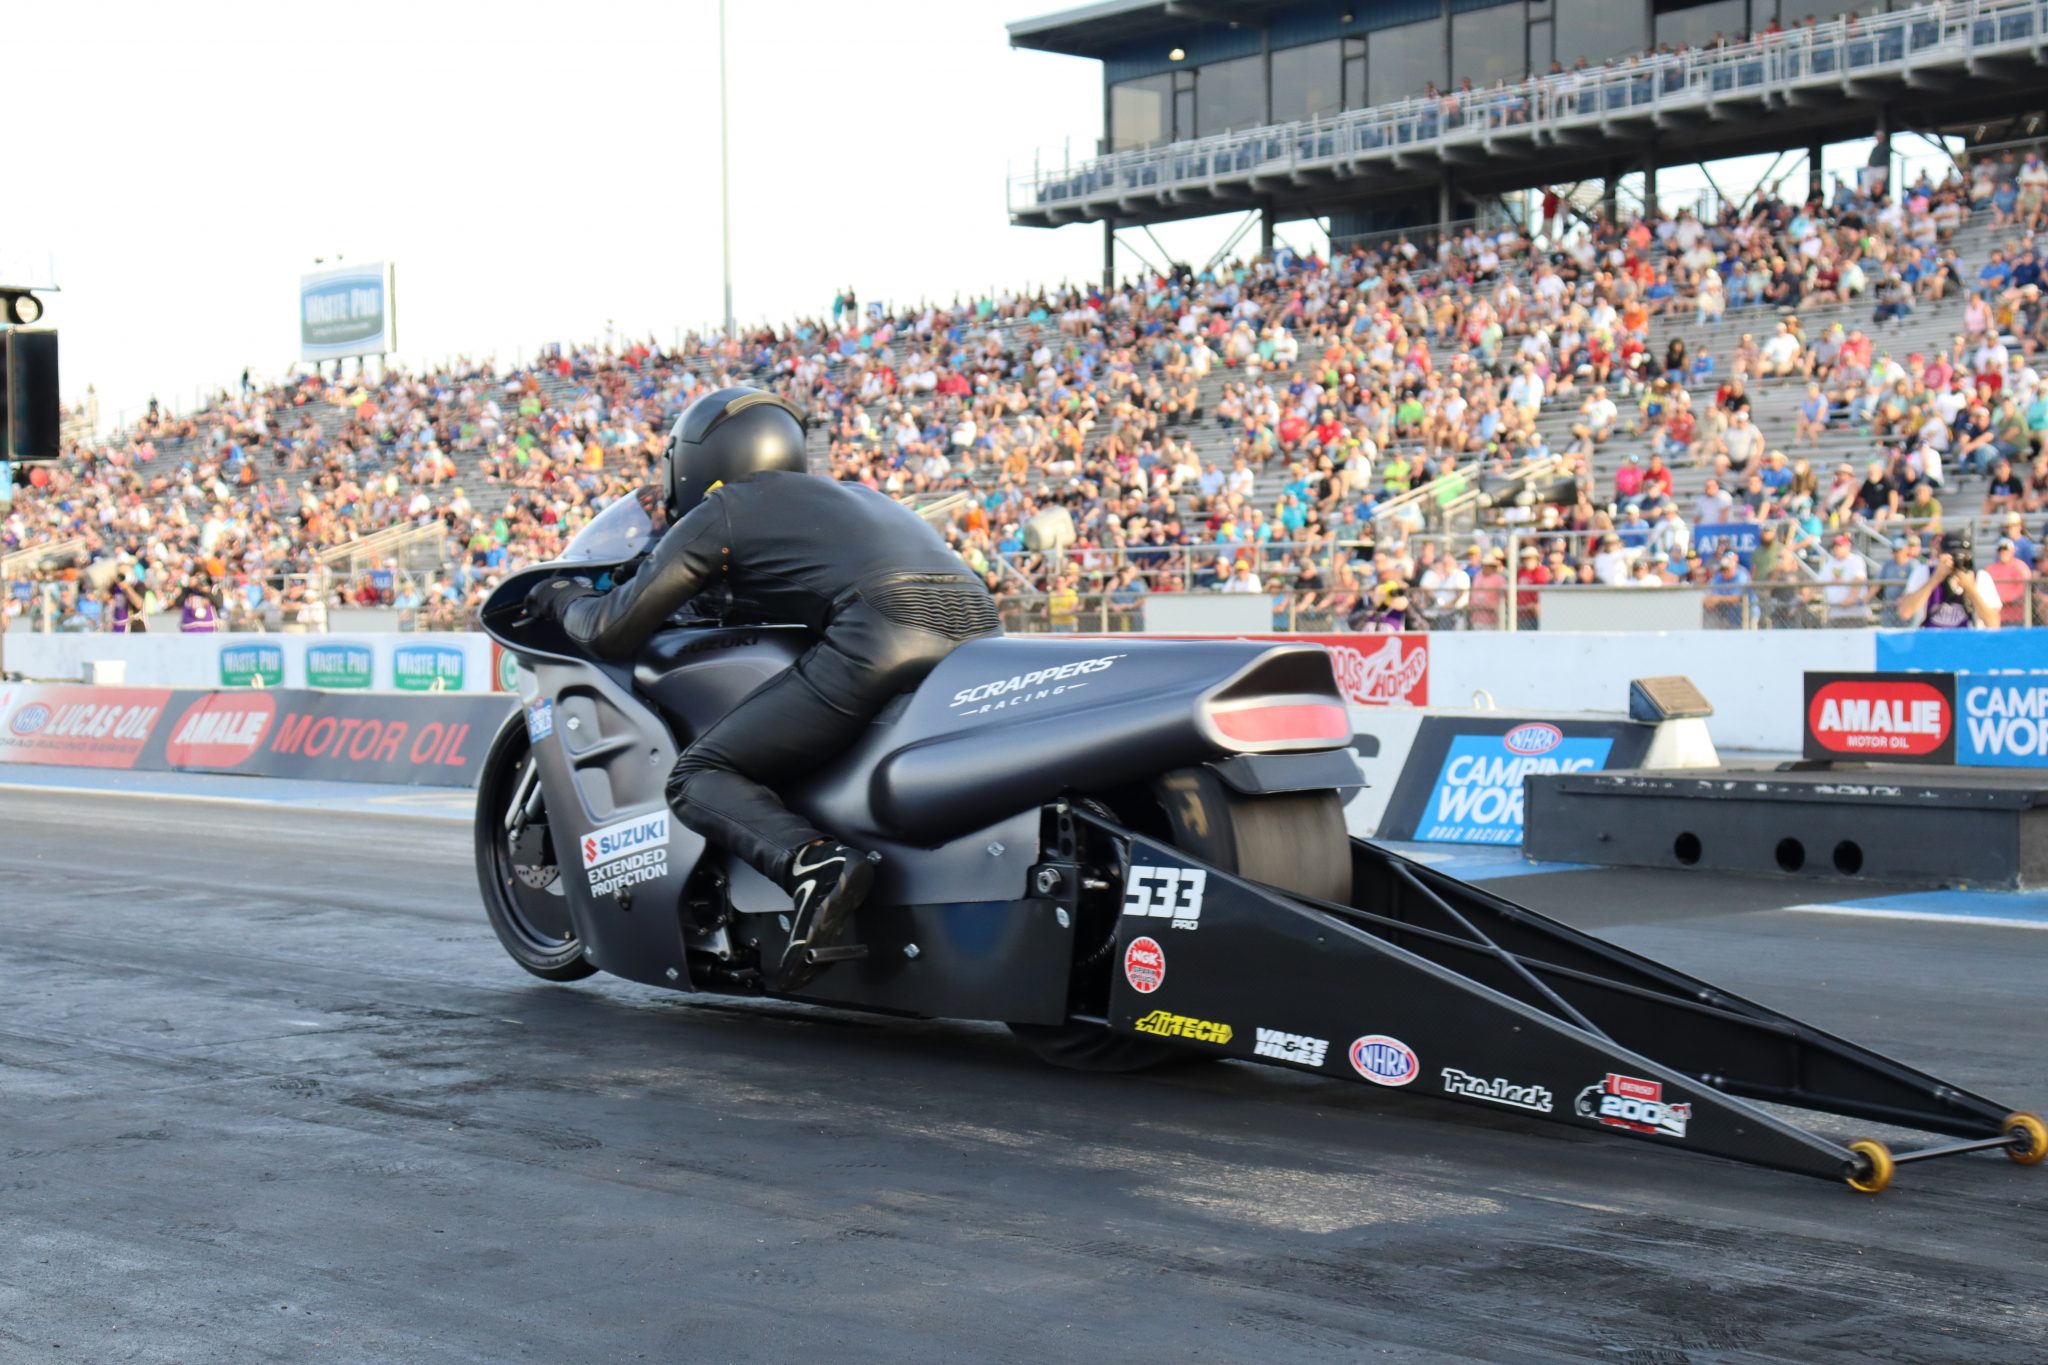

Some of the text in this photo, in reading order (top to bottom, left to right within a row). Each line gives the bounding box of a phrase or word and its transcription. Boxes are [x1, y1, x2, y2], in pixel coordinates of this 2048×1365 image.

[1698, 533, 1757, 554] AILE
[223, 650, 280, 673] WASTE PRO
[309, 650, 370, 674] WASTE PRO
[397, 651, 462, 677] WASTE PRO
[949, 654, 1123, 707] SCRAPPERS
[979, 685, 1066, 714] RACING
[43, 704, 124, 738] LUCAS
[113, 705, 158, 739] OIL
[174, 711, 269, 745] AMALIE
[1818, 698, 1941, 735] AMALIE
[271, 712, 471, 767] MOTOR OIL
[1510, 726, 1557, 751] NHRA
[1847, 735, 1910, 749] MOTOR OIL
[599, 819, 666, 855] SUZUKI
[1427, 825, 1463, 840] DRAG
[1464, 828, 1513, 842] RACING
[587, 848, 667, 885] EXTENDED
[590, 862, 669, 899] PROTECTION
[1122, 865, 1207, 920] 533
[1171, 919, 1199, 931] PRO
[1131, 949, 1159, 967] NGK
[1359, 1044, 1409, 1077] NHRA
[1600, 1095, 1661, 1125] 200
